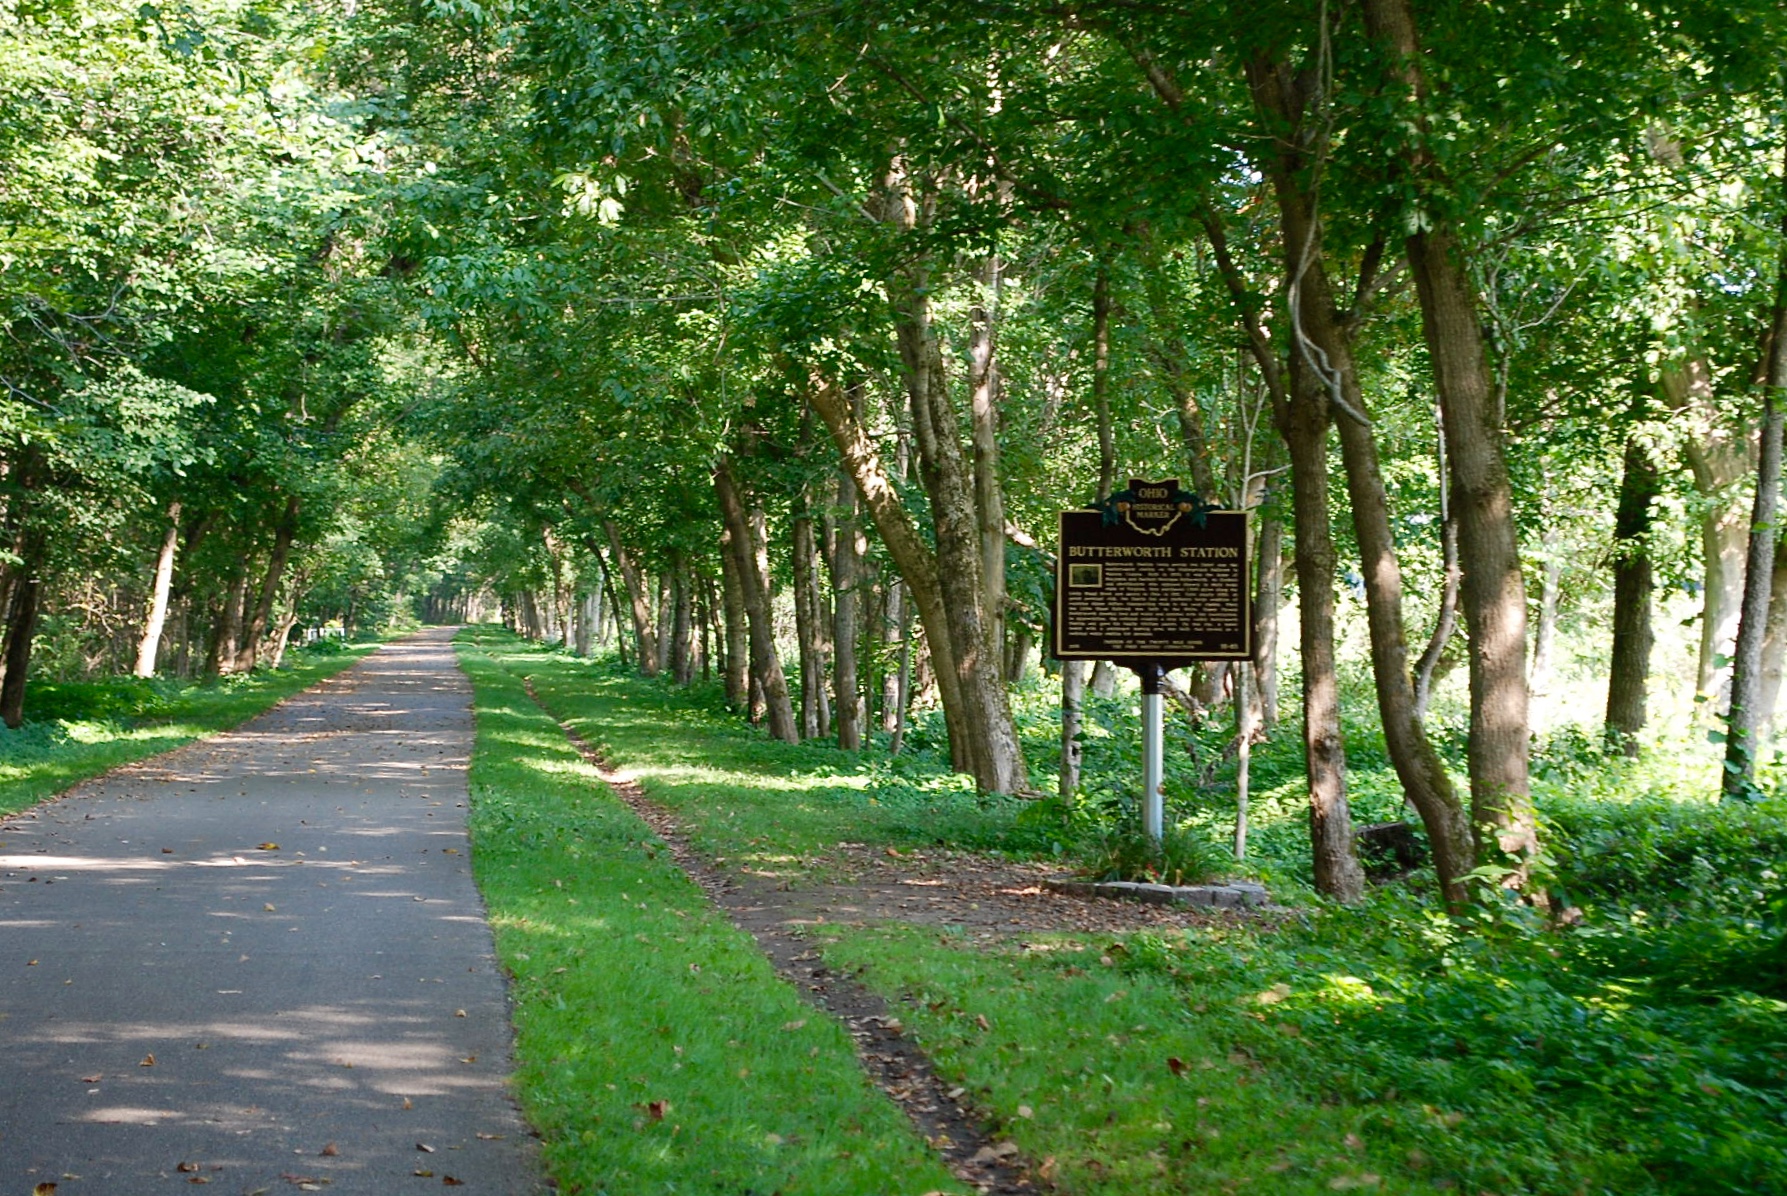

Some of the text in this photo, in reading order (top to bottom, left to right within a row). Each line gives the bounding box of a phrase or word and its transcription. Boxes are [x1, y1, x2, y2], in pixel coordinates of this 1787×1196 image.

[1138, 487, 1168, 499] OHIO
[1068, 546, 1239, 559] BUTTERWORTH STATION
